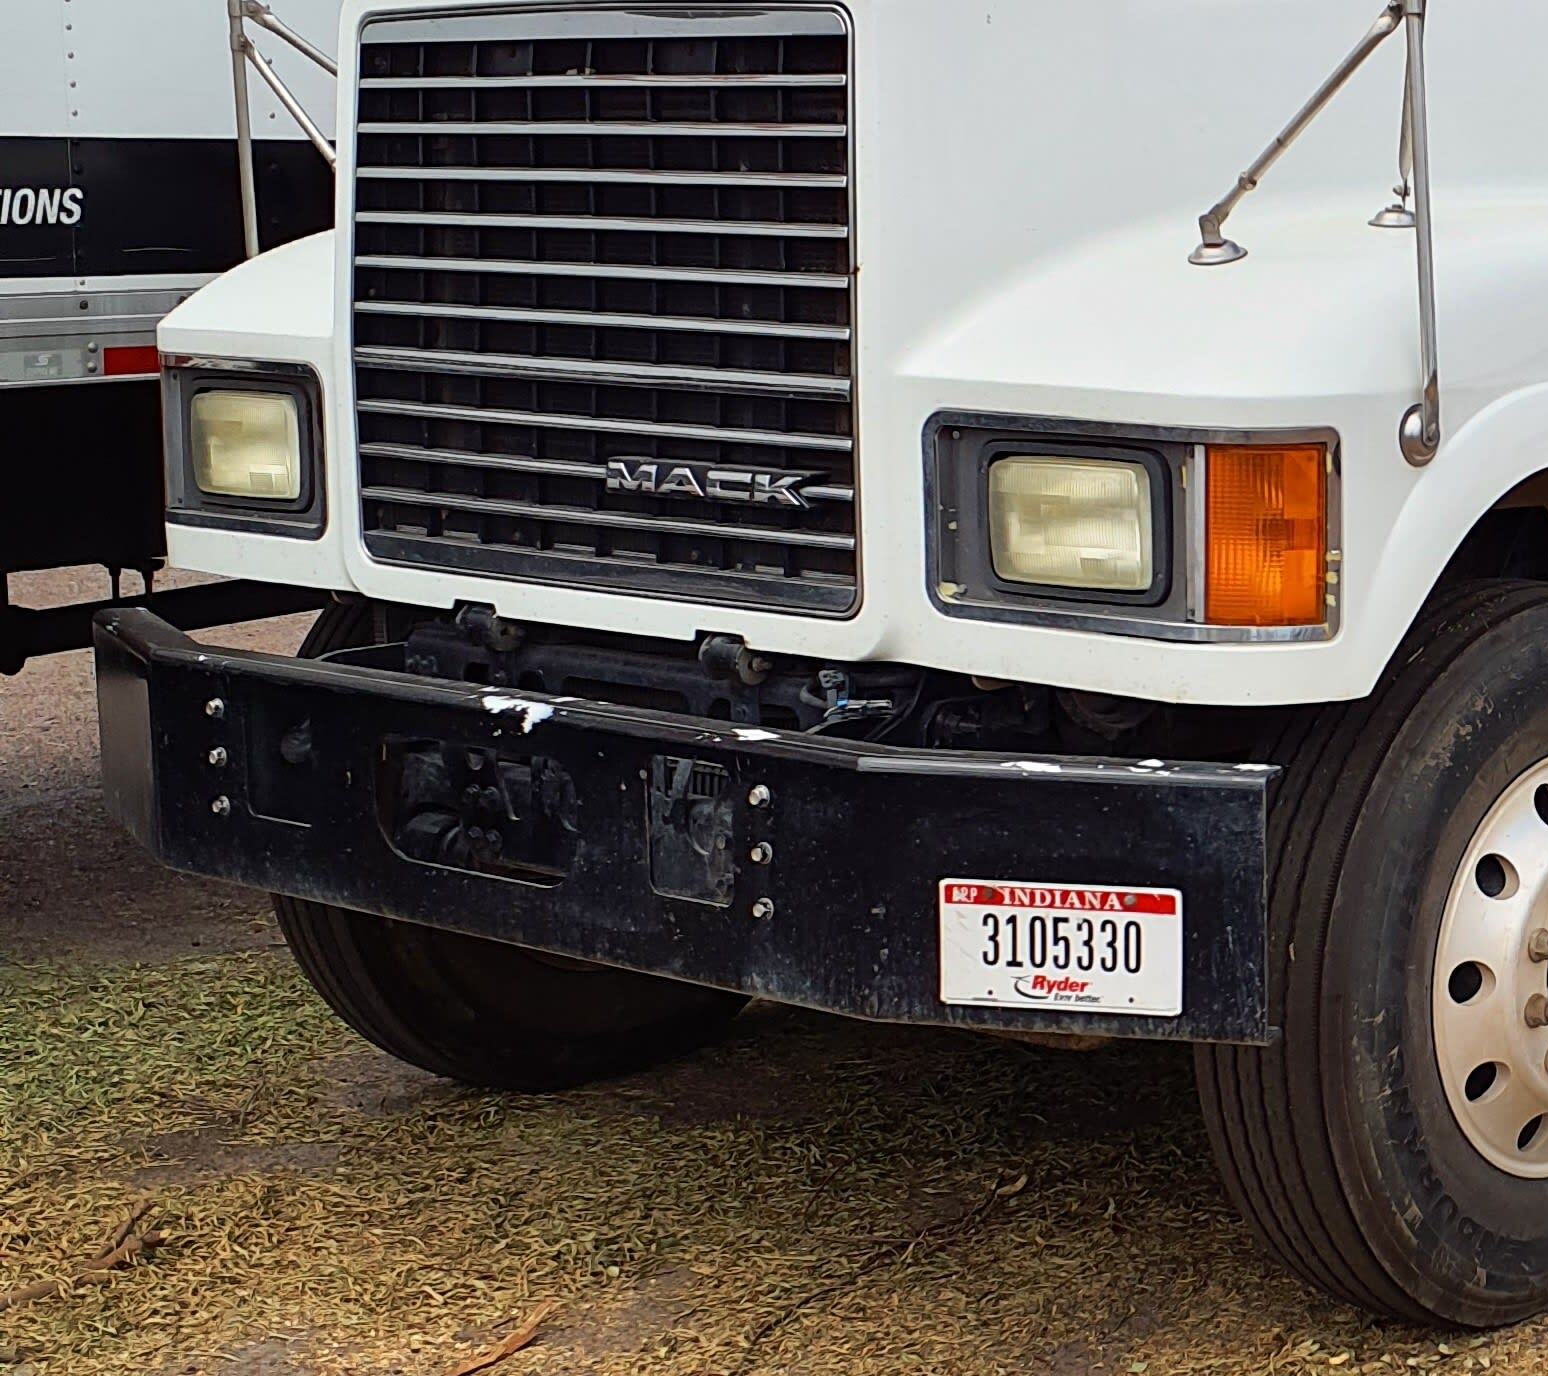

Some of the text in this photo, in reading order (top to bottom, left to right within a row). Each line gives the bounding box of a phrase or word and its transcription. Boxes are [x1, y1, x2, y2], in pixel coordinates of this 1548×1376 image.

[0, 188, 83, 225] IONS
[606, 461, 807, 508] MACK
[1003, 887, 1124, 911] INDIANA
[982, 913, 1142, 974] 3105330
[1031, 974, 1089, 994] Ryder
